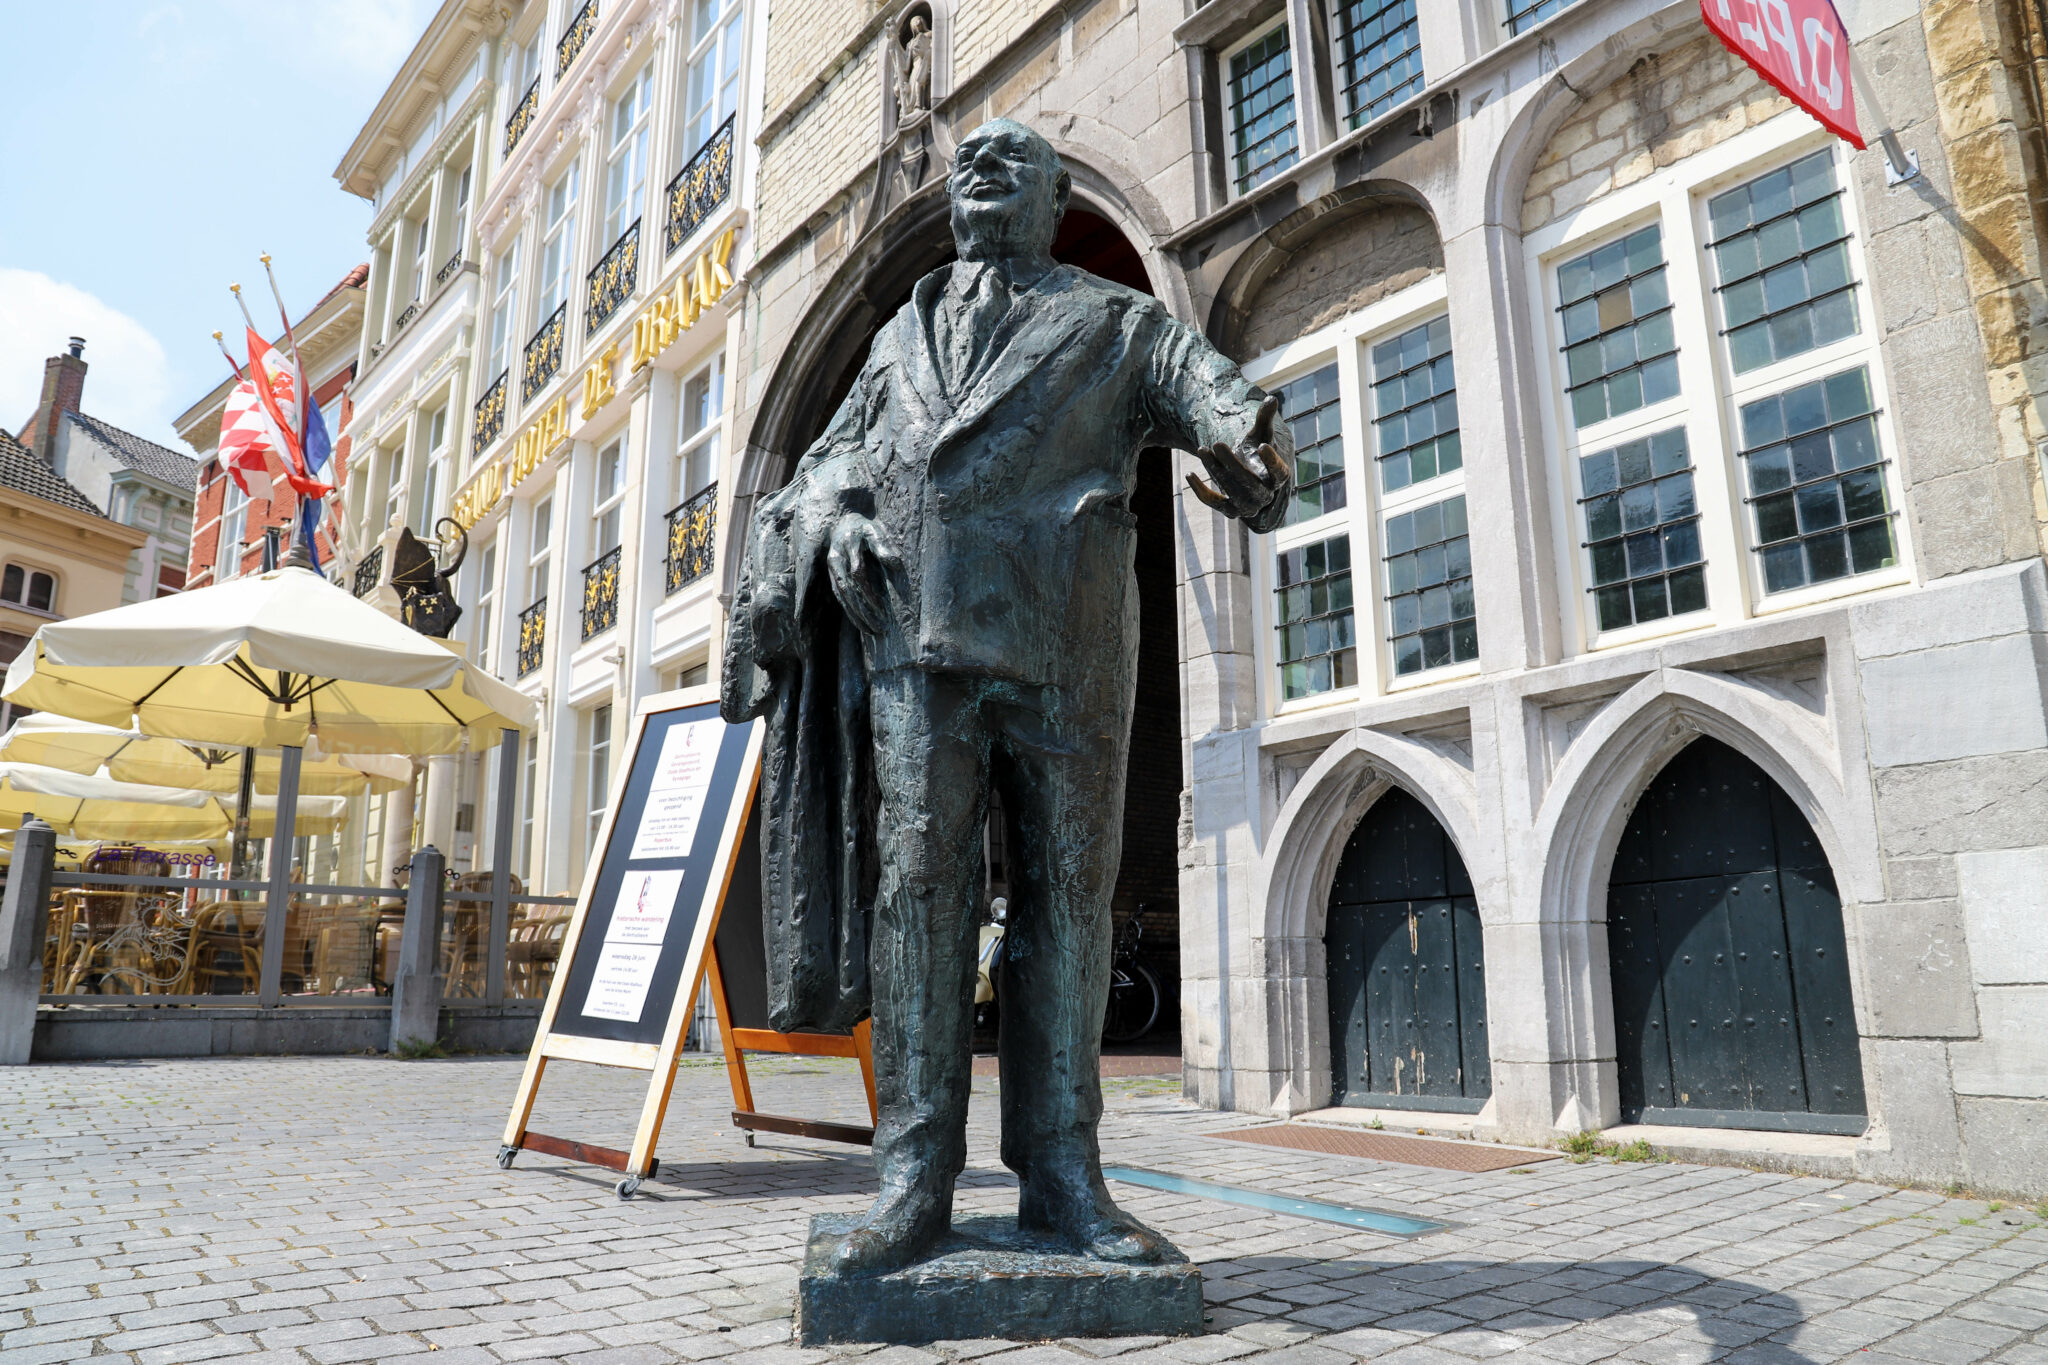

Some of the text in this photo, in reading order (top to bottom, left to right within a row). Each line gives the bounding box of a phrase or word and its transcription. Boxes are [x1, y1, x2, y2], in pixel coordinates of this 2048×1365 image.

[510, 394, 570, 488] HOTEL
[581, 340, 618, 421] DE
[630, 227, 735, 374] DRAAK
[95, 844, 217, 867] La Terrasse
